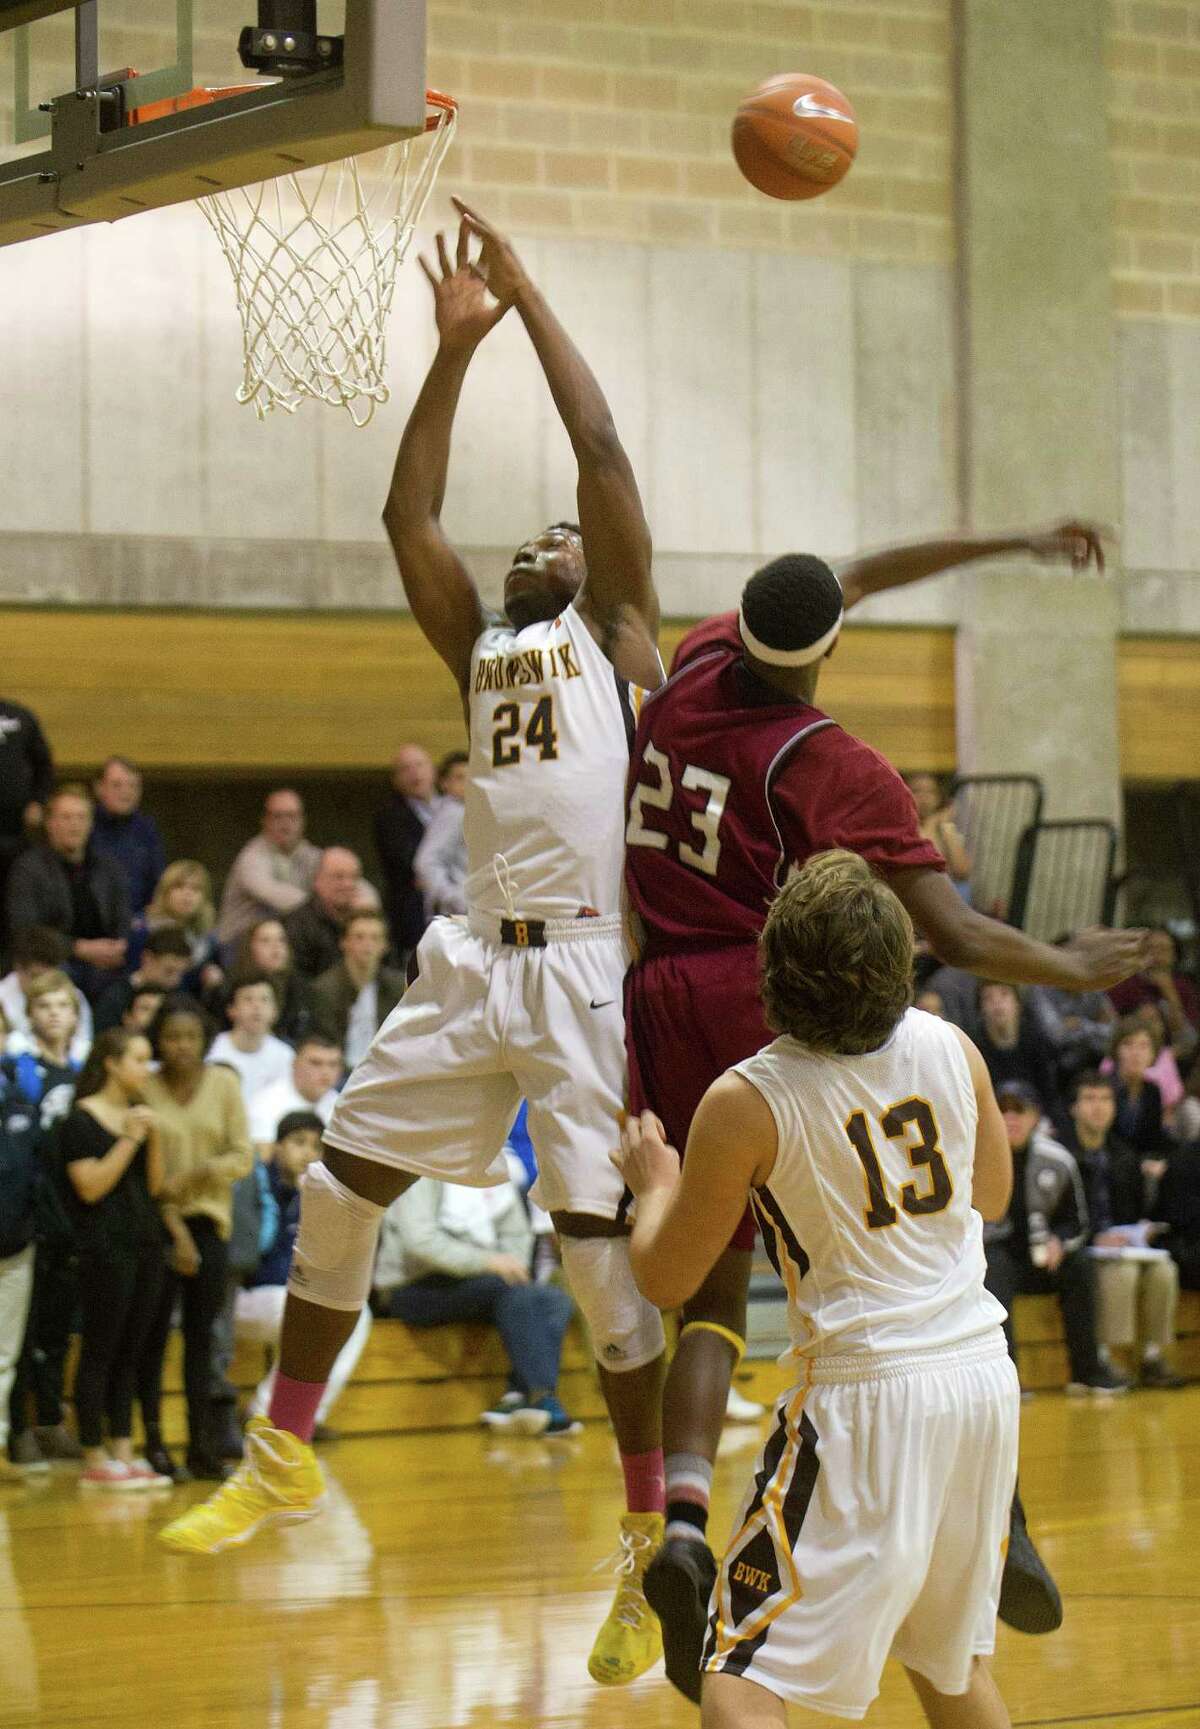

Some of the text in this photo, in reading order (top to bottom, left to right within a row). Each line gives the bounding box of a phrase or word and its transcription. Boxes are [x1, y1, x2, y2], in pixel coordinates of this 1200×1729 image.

[492, 694, 558, 767] 24
[626, 740, 731, 876] 23
[843, 1094, 953, 1231] 13
[733, 1561, 772, 1592] BWK
